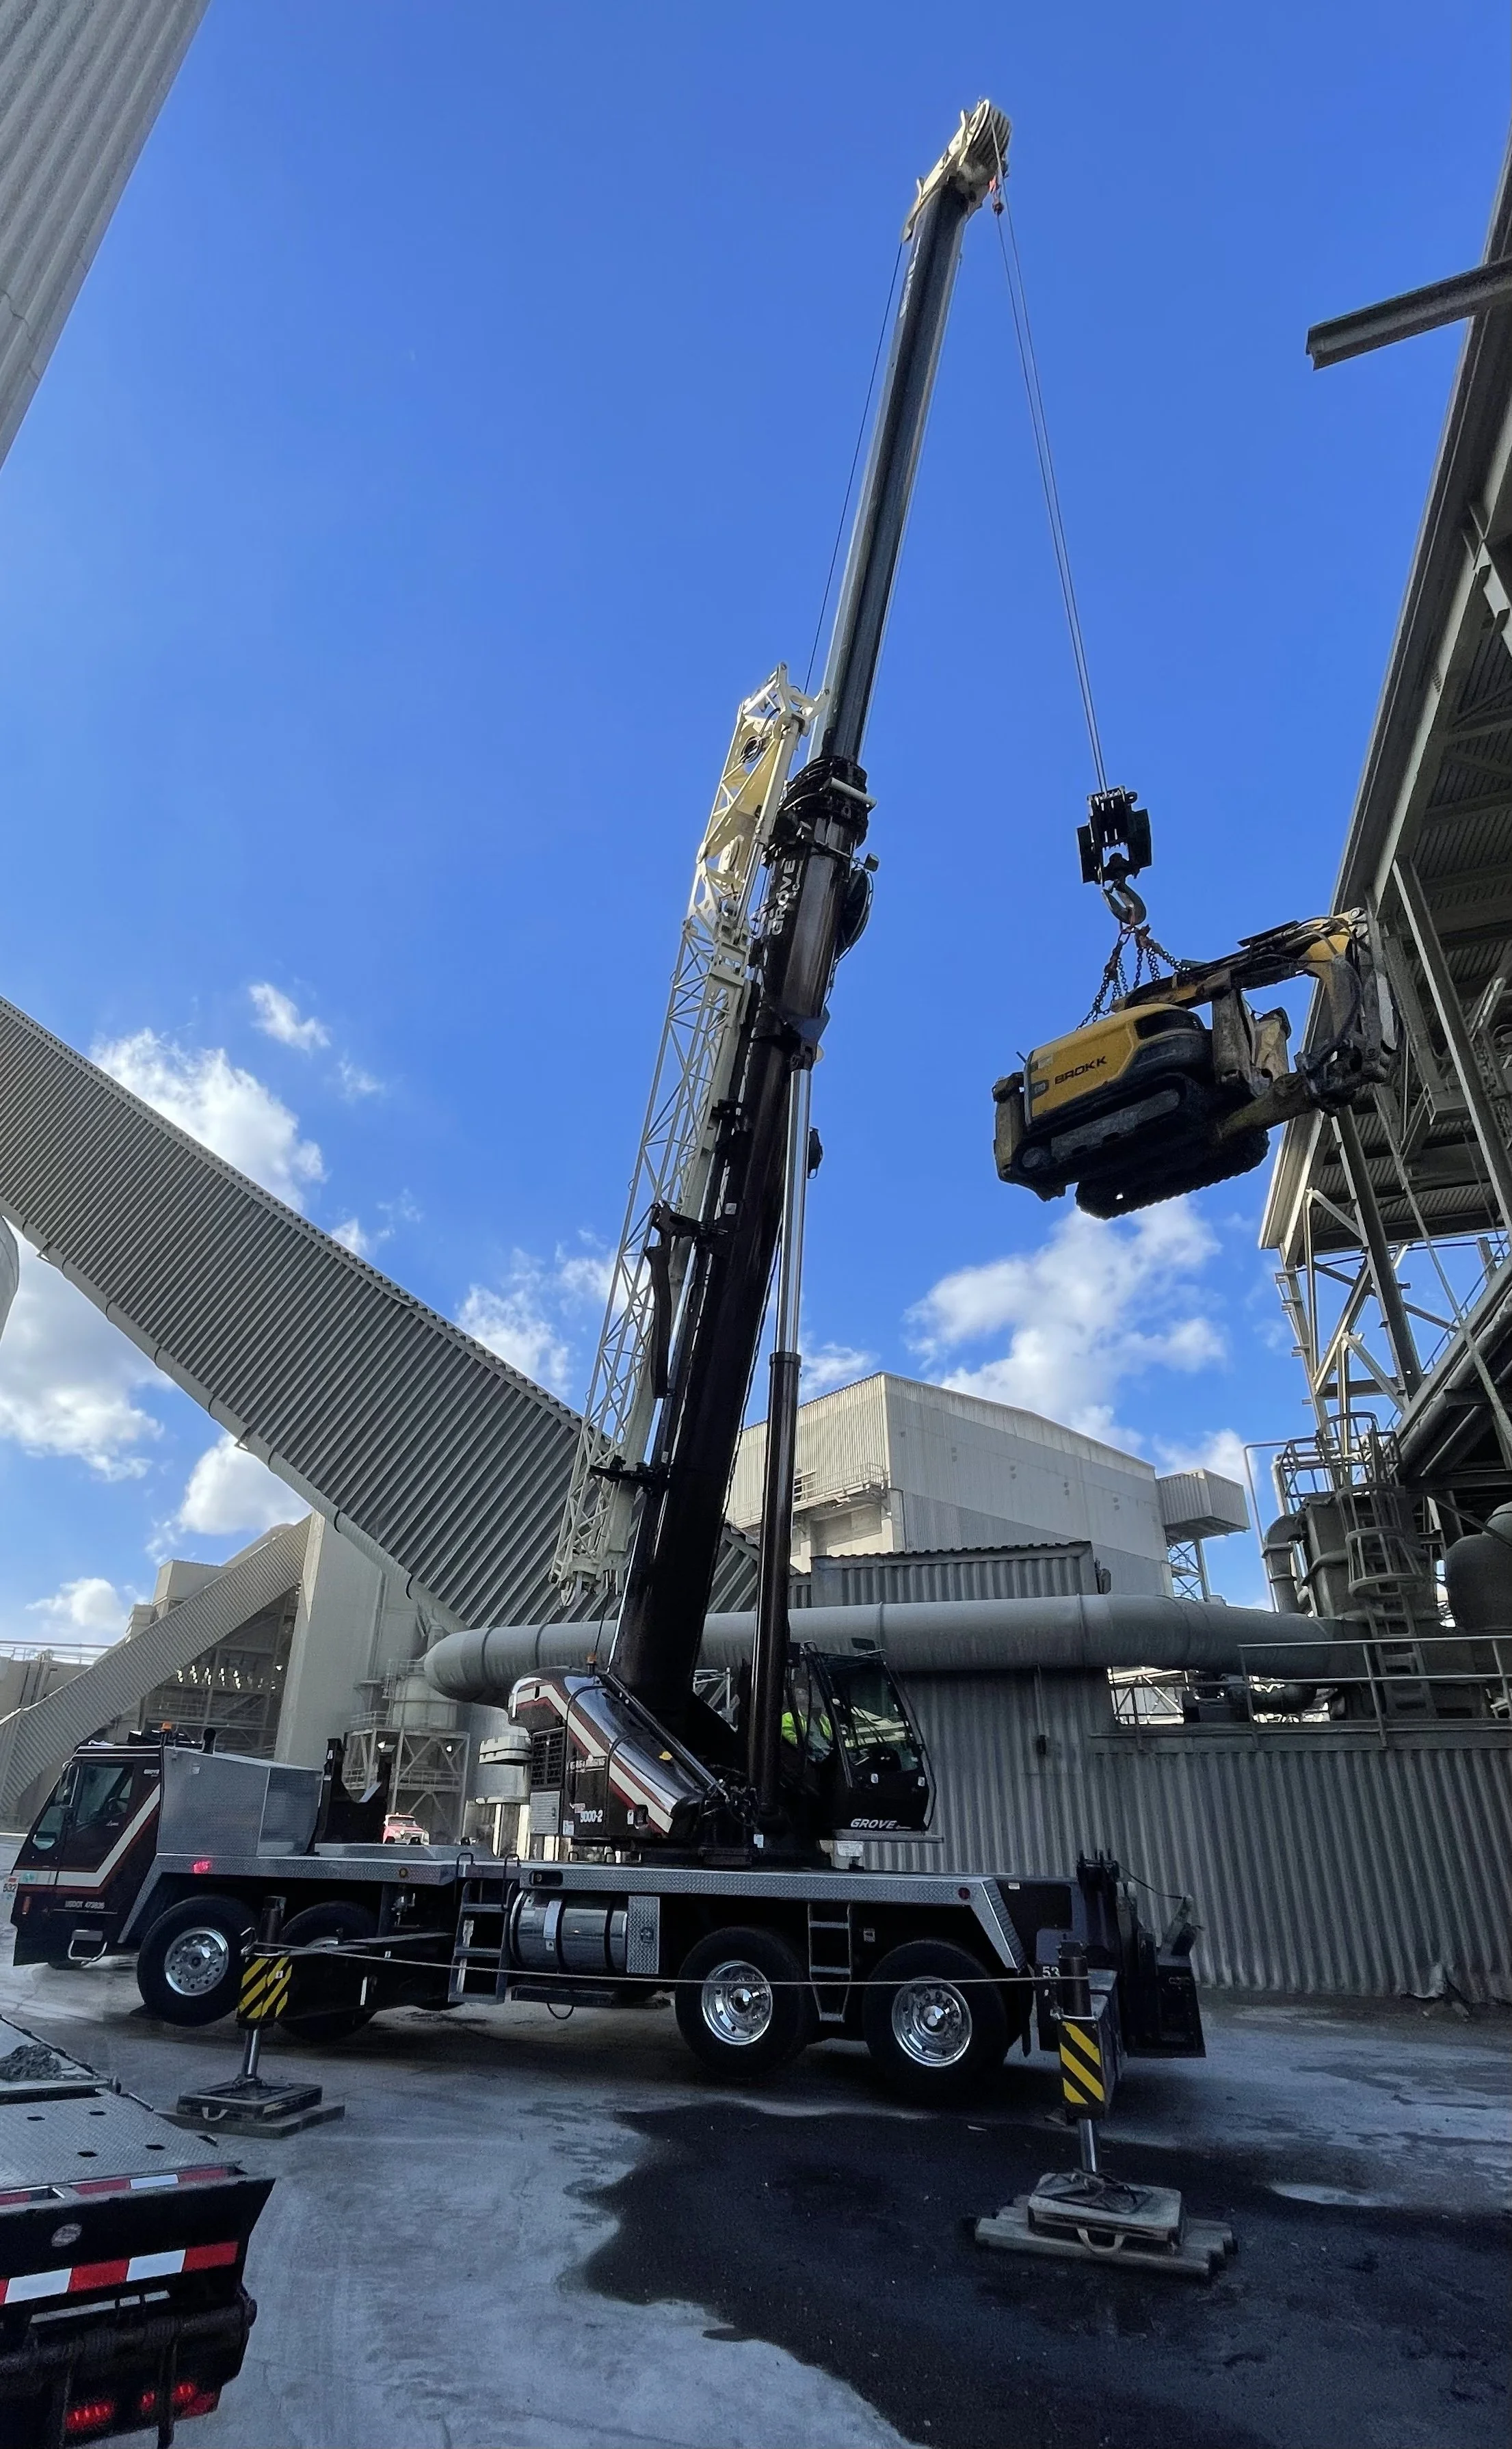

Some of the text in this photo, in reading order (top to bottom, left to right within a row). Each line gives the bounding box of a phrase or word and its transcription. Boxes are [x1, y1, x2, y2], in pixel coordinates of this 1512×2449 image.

[771, 859, 796, 936] GROVE
[1055, 1056, 1106, 1085] BROKK
[850, 1818, 898, 1829] GROVE
